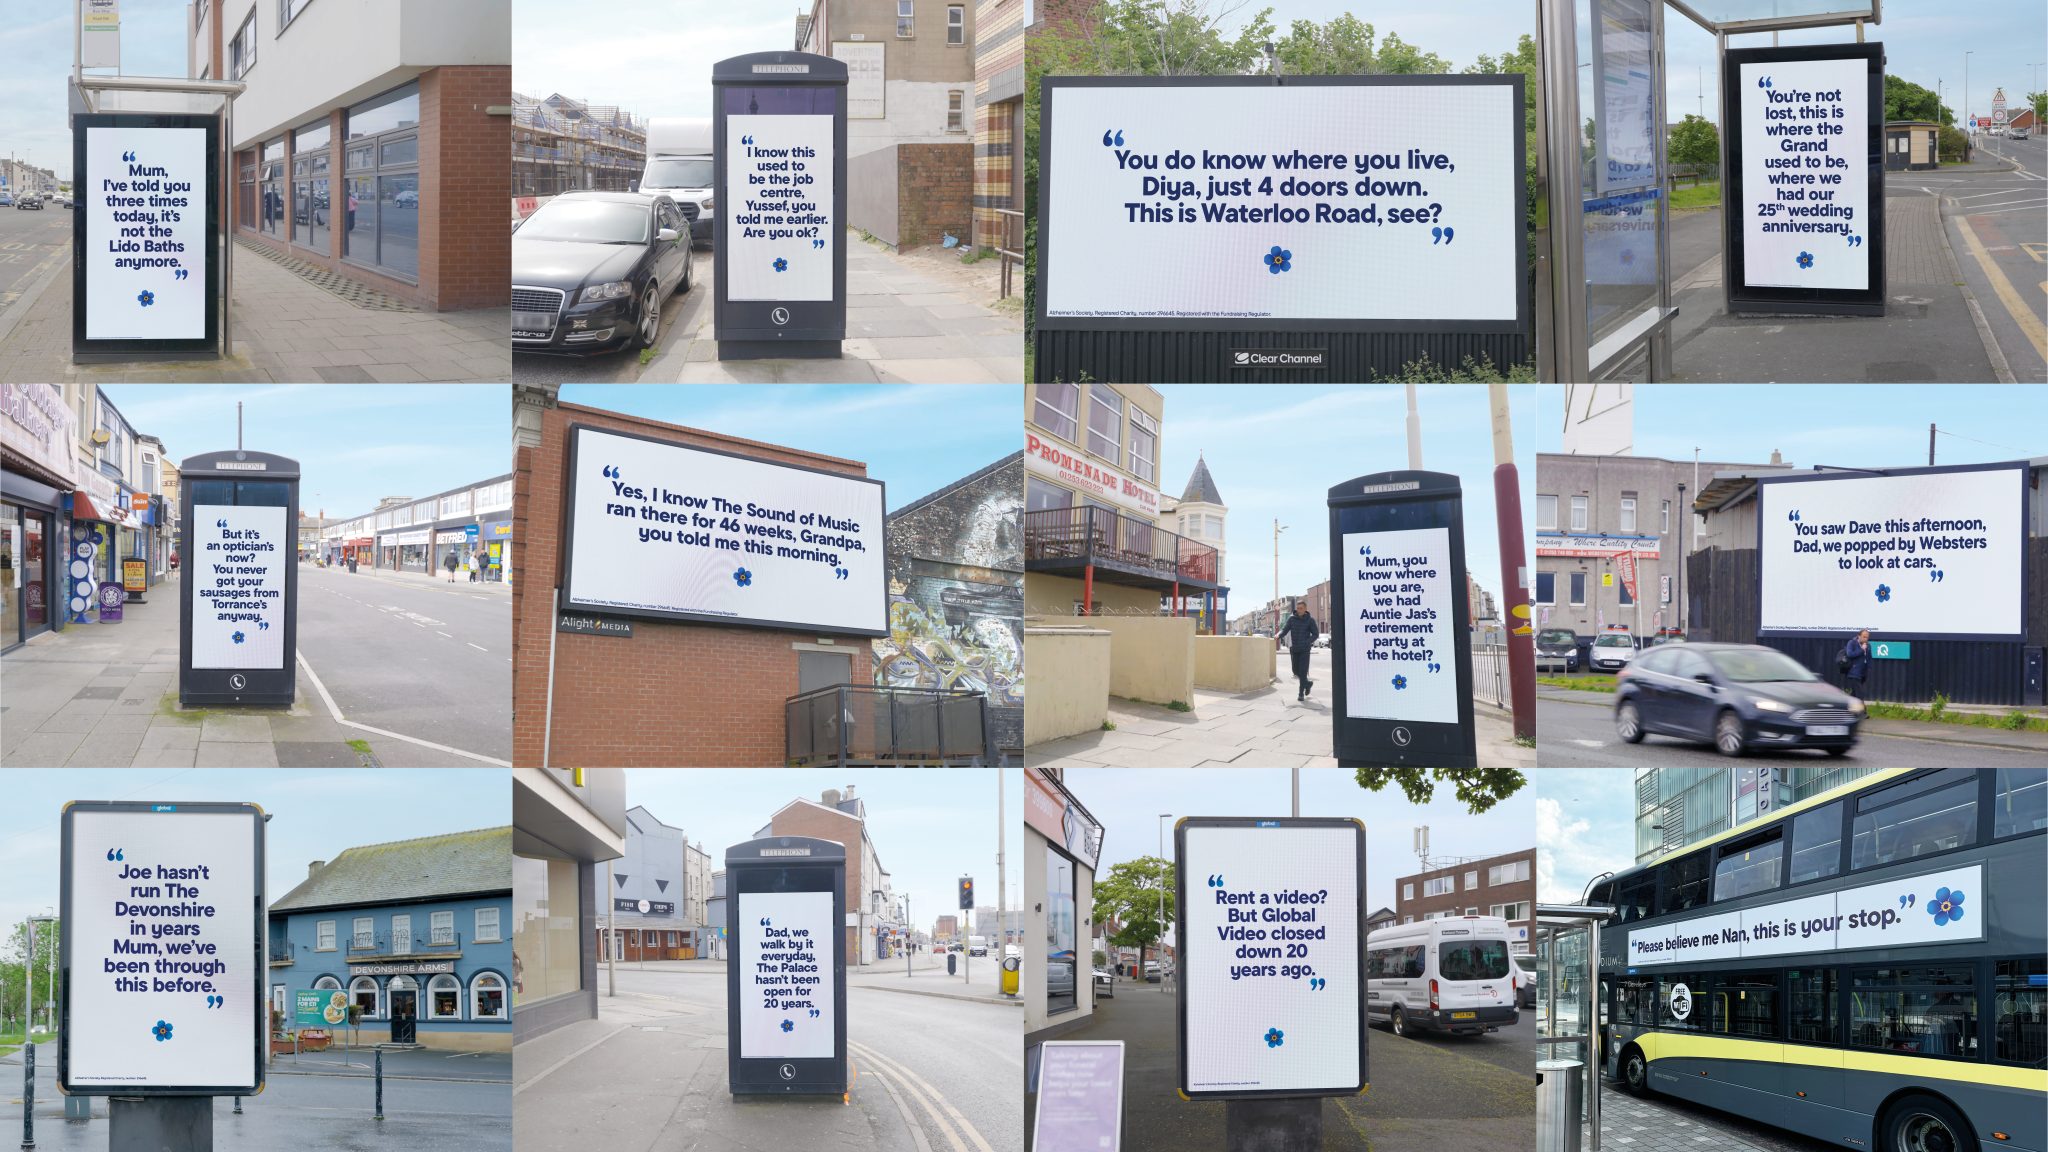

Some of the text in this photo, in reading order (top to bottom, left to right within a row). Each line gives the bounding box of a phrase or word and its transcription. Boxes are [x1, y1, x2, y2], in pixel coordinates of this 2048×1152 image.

[1766, 89, 1841, 103] You’re not
[748, 146, 815, 158] I know this
[1781, 138, 1827, 152] Grand
[1114, 149, 1454, 174] You do know where you live,
[1765, 155, 1848, 170] used to be,
[129, 164, 168, 178] Mum,
[104, 179, 190, 194] I’ve told you
[760, 188, 805, 199] centre,
[106, 194, 188, 207] three times
[746, 200, 816, 214] Yussef, you
[1124, 202, 1442, 227] This is Waterloo Road, see?
[1758, 203, 1853, 220] 25th wedding
[1762, 219, 1853, 236] anniversary.
[110, 240, 184, 252] Lido Baths
[1250, 353, 1322, 364] Clear Channel
[612, 481, 860, 533] Yes, I know The Sound of Music
[607, 503, 865, 553] ran there for 46 weeks, Grandpa,
[1795, 518, 1986, 535] You saw Dave this afternoon,
[222, 529, 260, 539] But it’s
[436, 532, 468, 544] BETFRED
[223, 541, 274, 553] optician’s
[1794, 536, 1987, 555] Dad, we popped by Websters
[213, 564, 233, 574] You
[1366, 556, 1427, 568] Mum, you
[200, 588, 279, 600] sausages from
[211, 599, 267, 609] Torrance’s
[217, 613, 263, 623] anyway.
[1360, 608, 1436, 619] Auntie Jas’s
[561, 616, 630, 632] Alight MEDIA
[1365, 622, 1433, 633] retirement
[1374, 637, 1425, 649] party at
[1367, 649, 1433, 661] the hotel?
[118, 864, 209, 880] Joe hasn’t
[131, 883, 199, 898] run The
[1216, 889, 1327, 904] Rent a video?
[116, 901, 215, 917] Devonshire
[1228, 908, 1315, 922] But Global
[1217, 926, 1325, 940] Video closed
[1665, 936, 1700, 951] believe
[1701, 934, 1719, 947] me
[1722, 927, 1750, 945] Nan,
[1753, 922, 1780, 940] this
[1784, 918, 1796, 936] is
[1801, 915, 1844, 939] your
[761, 951, 815, 963] everyday,
[104, 958, 225, 977] been through
[355, 963, 447, 974] DEVONSHIRE ARMS
[757, 963, 818, 972] The Palace
[1675, 988, 1686, 996] FREE
[764, 999, 814, 1010] 20 years.
